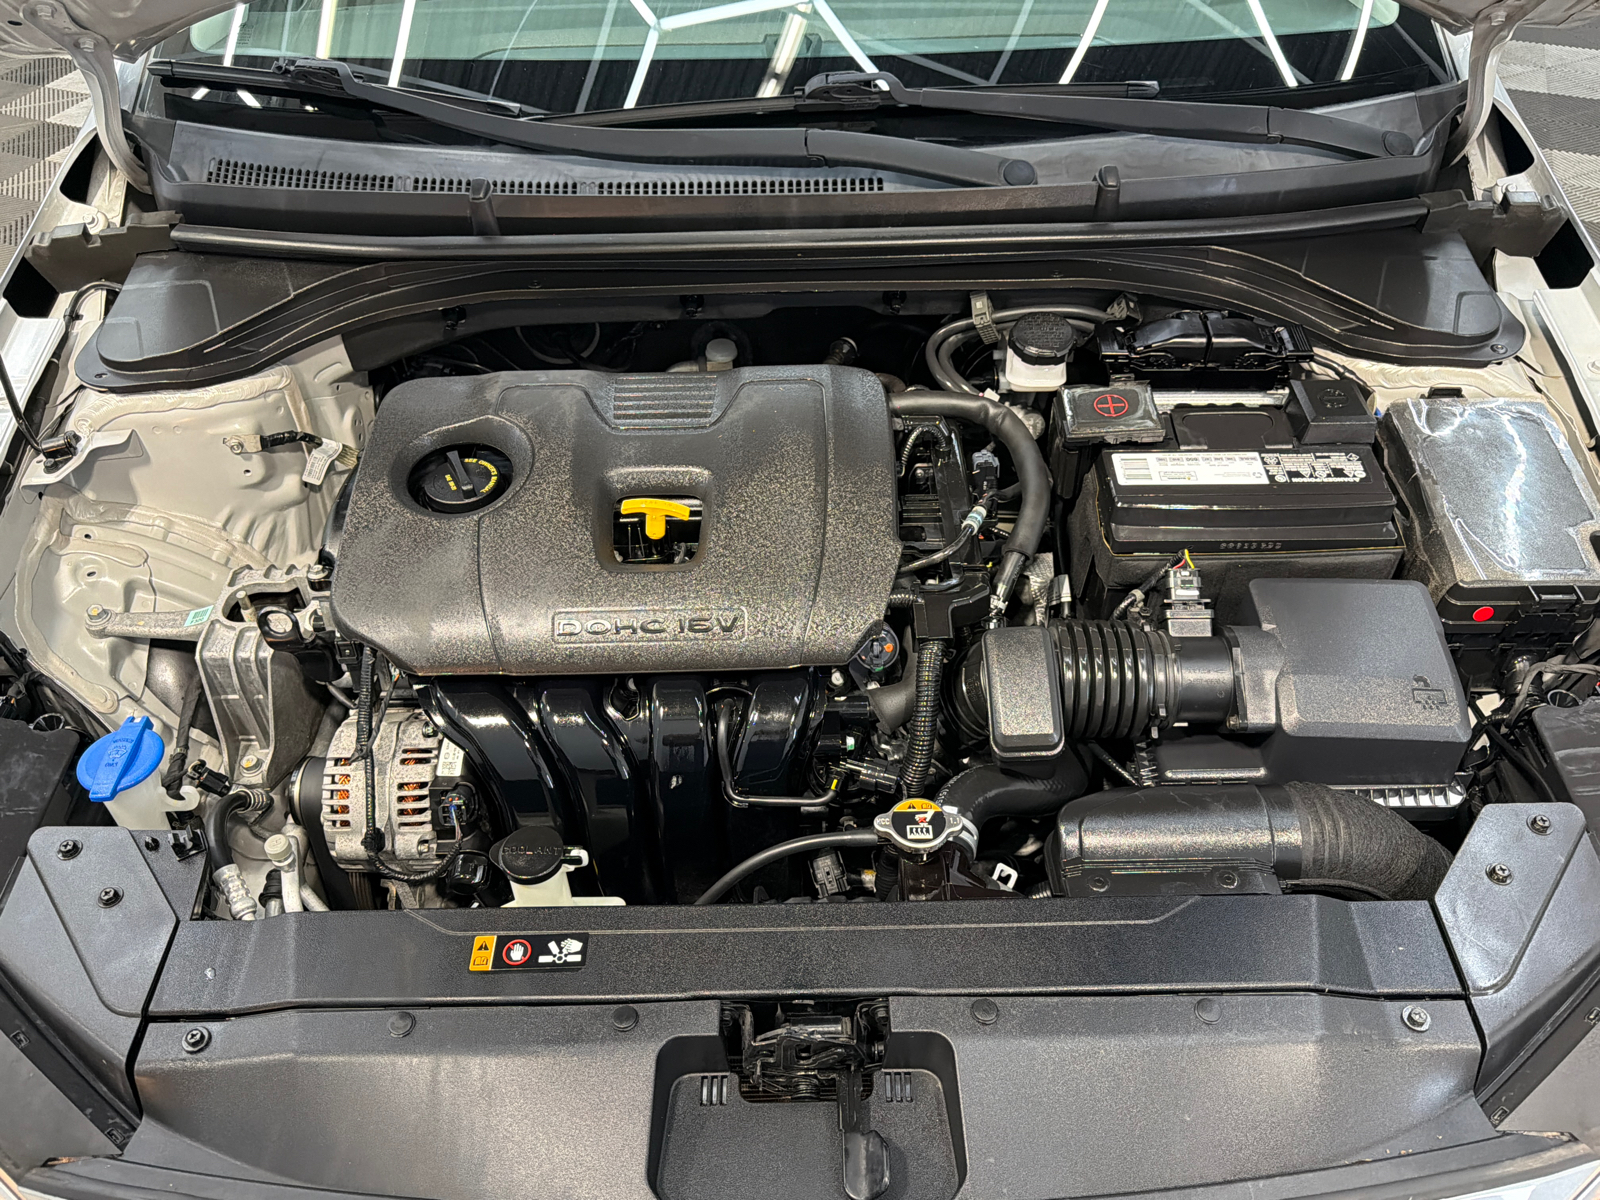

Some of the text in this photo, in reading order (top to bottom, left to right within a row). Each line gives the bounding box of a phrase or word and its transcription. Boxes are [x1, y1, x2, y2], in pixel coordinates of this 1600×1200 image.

[480, 476, 498, 493] MANUAL
[556, 615, 740, 636] DOHC 16V
[949, 817, 960, 825] 1.1
[502, 846, 562, 855] COOLANT
